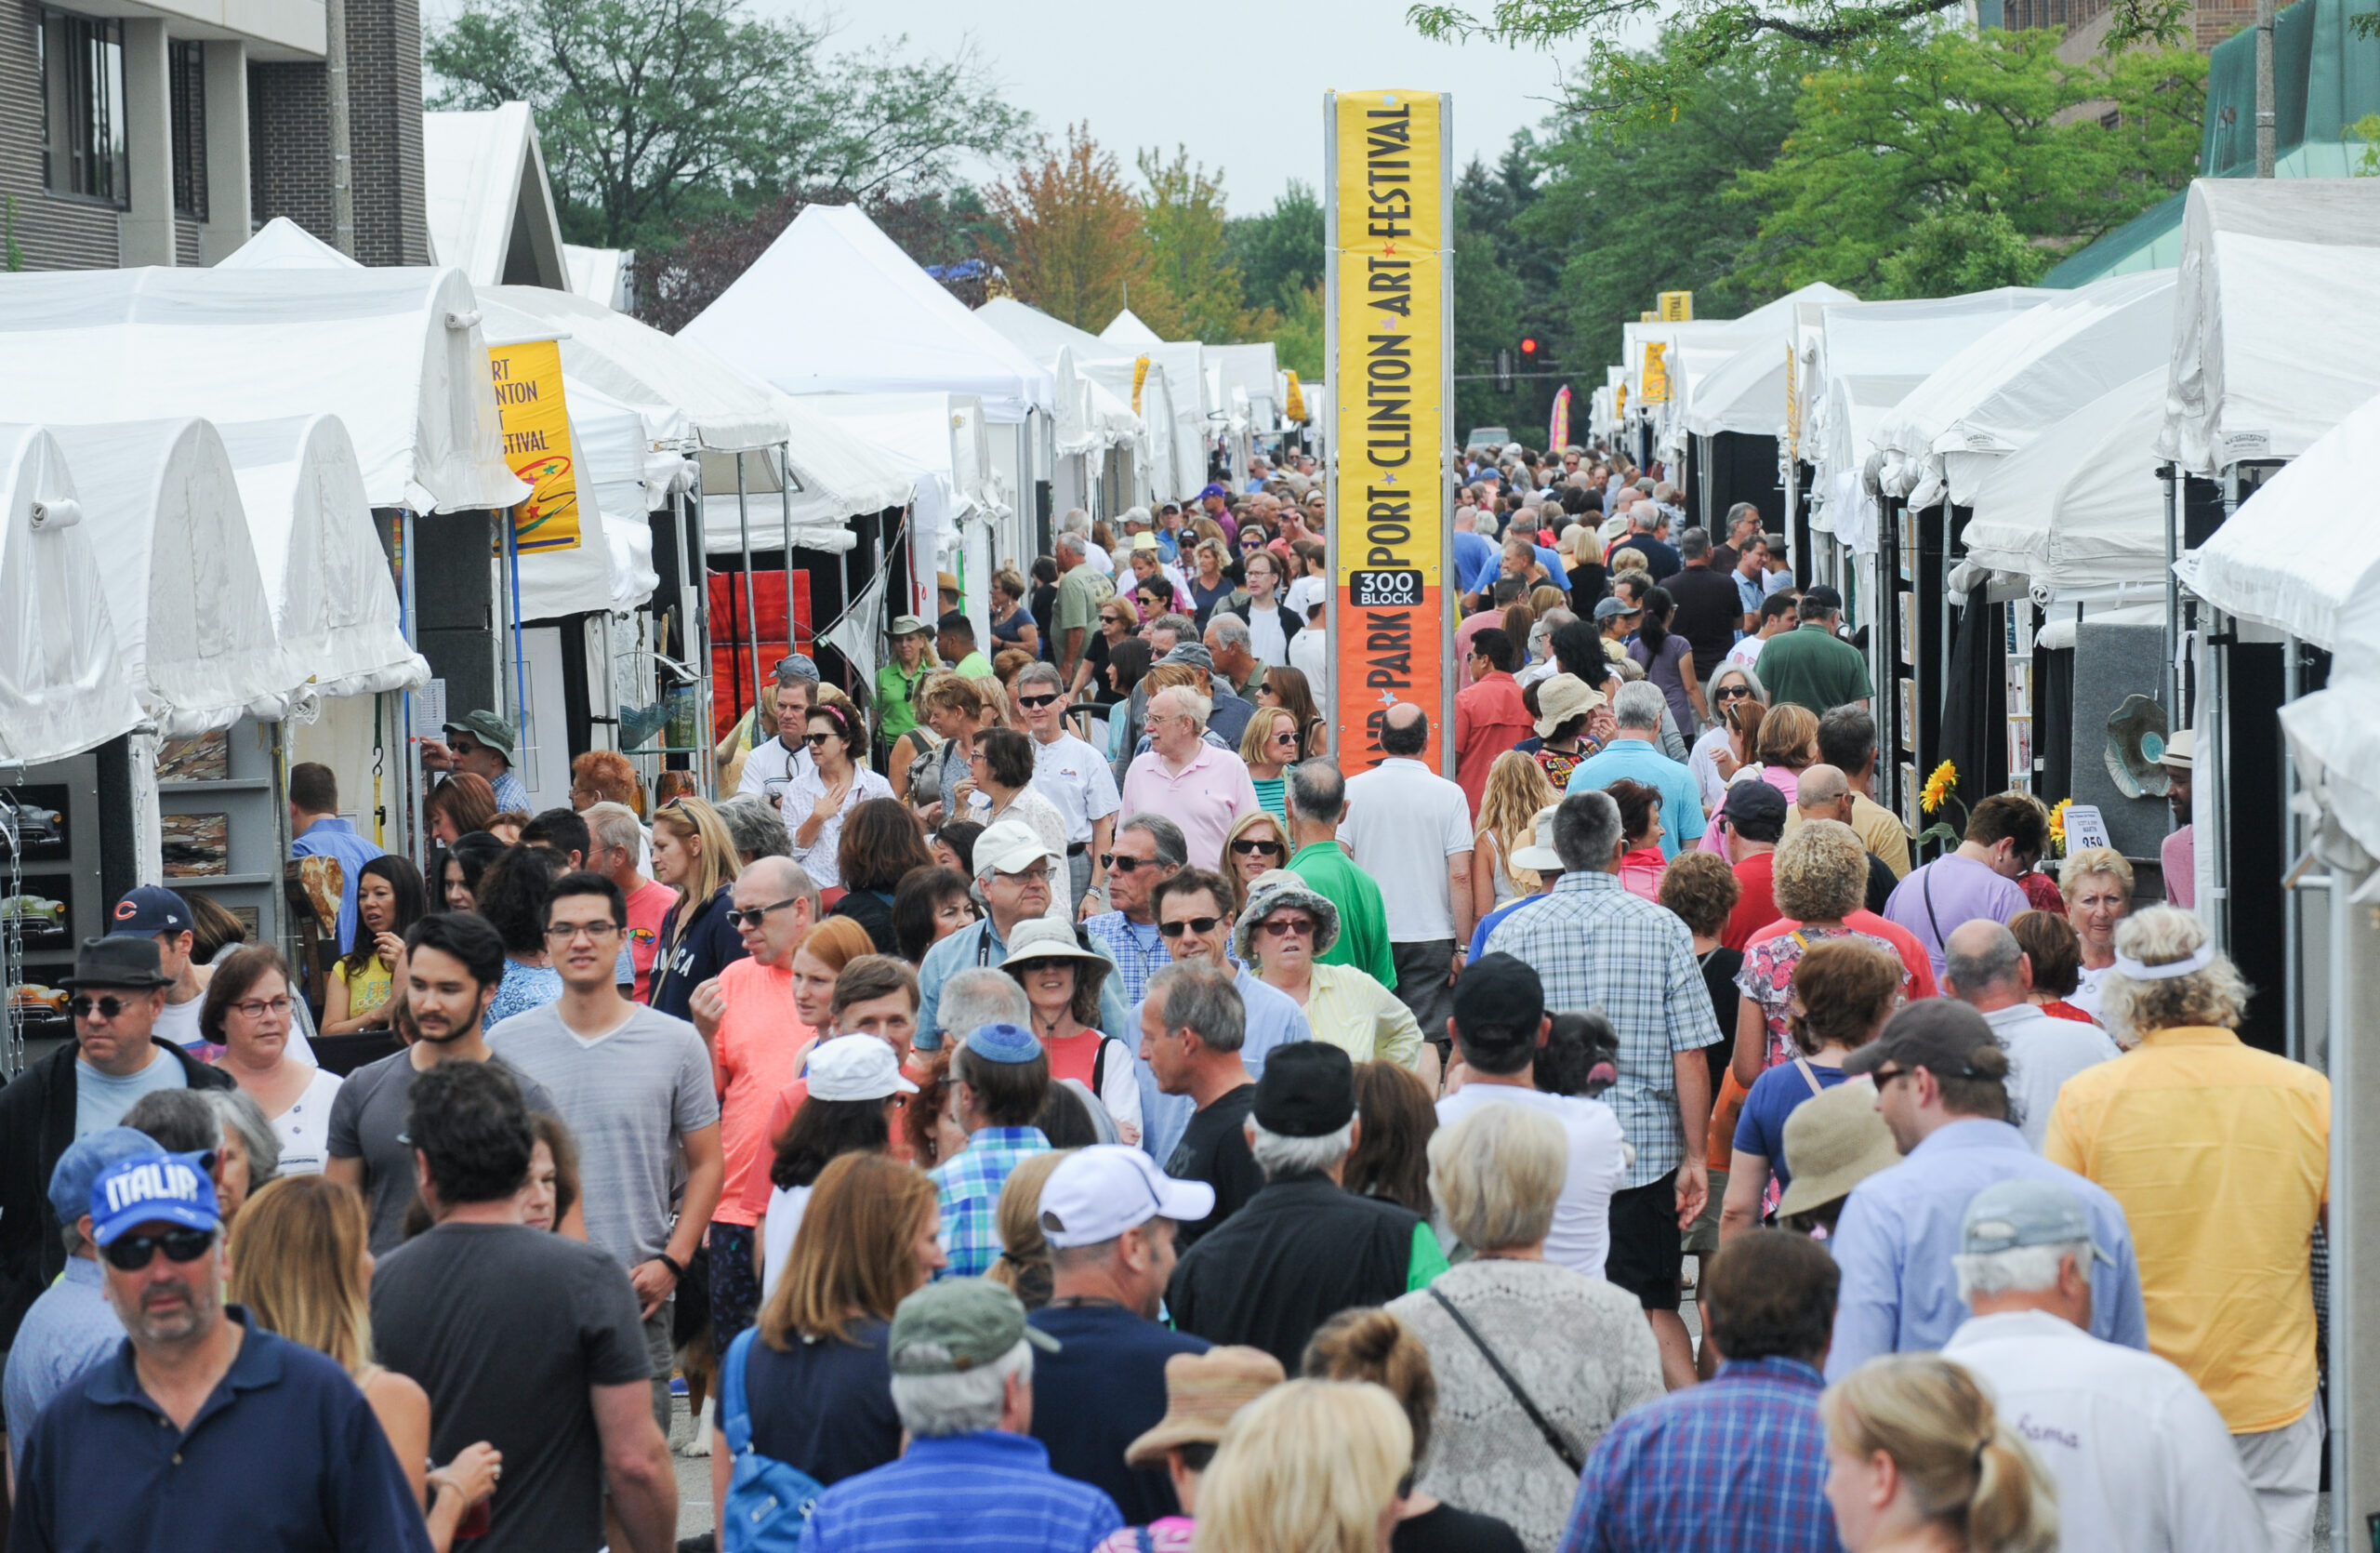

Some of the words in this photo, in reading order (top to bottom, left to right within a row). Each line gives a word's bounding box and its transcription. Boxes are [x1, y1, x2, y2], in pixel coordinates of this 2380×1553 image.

[1366, 103, 1411, 239] FESTIVAL
[1367, 256, 1411, 317] ART
[491, 358, 509, 381] RT
[495, 379, 538, 405] NTON
[1367, 334, 1412, 468] CLINTON
[503, 430, 550, 455] TIVAL
[1367, 484, 1411, 566] PORT
[1360, 572, 1414, 592] 300
[1360, 591, 1414, 604] BLOCK
[1366, 610, 1411, 688] PARK
[105, 1162, 199, 1214] ITALIA
